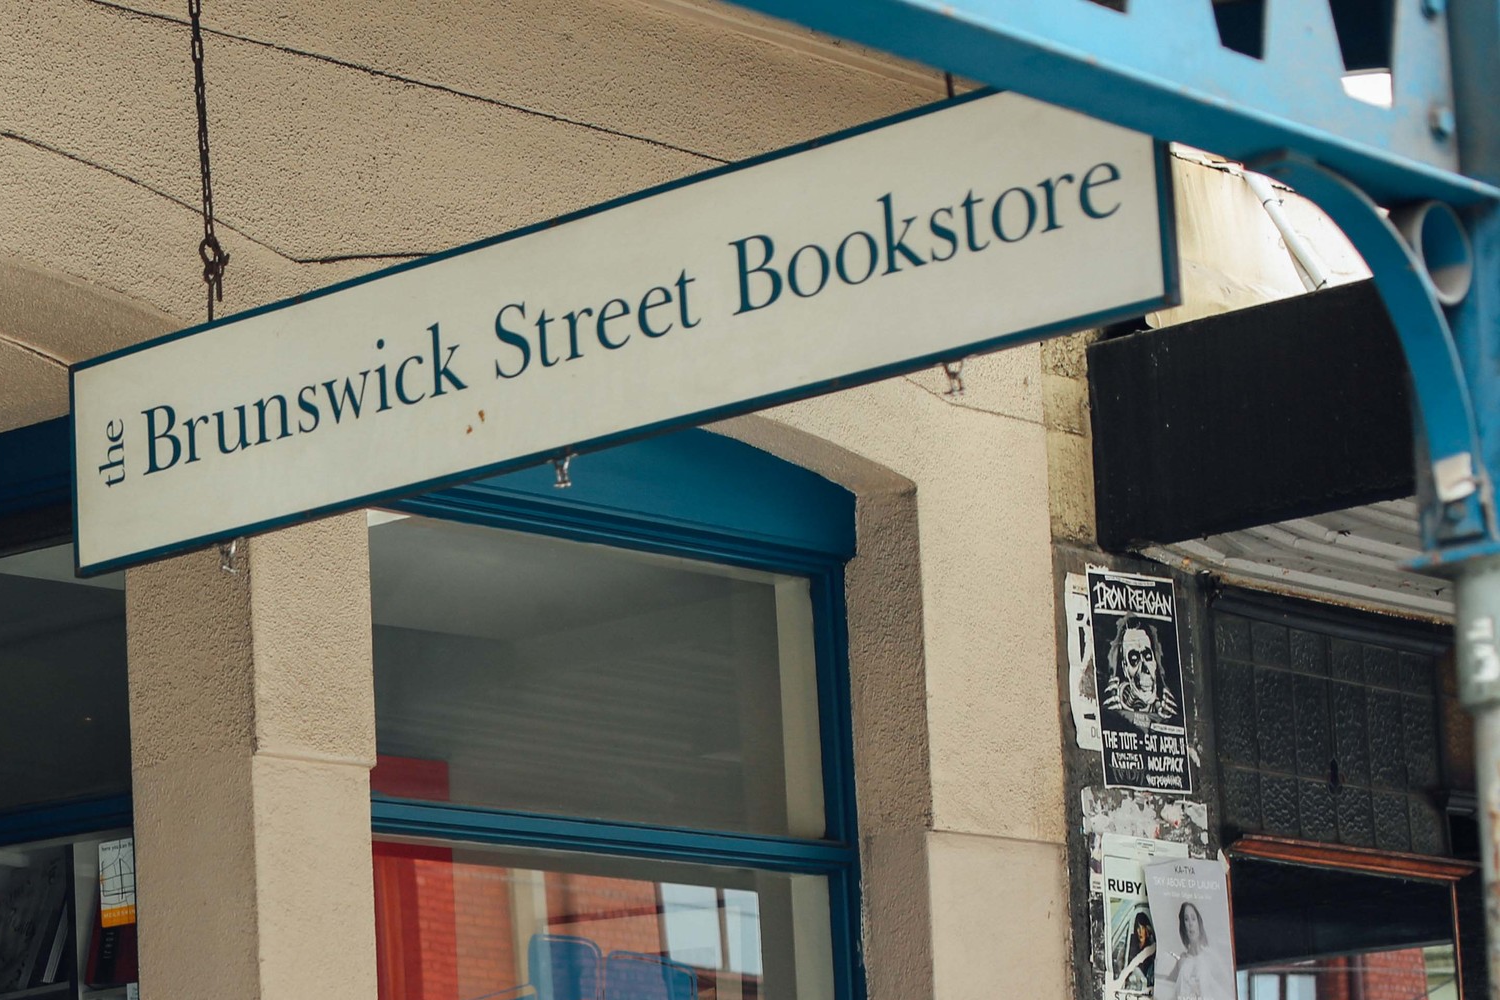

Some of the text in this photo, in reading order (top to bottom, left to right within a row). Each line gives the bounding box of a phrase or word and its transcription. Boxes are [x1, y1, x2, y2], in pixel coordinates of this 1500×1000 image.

[98, 160, 1123, 489] the Brunswick Street Bookstore
[1093, 581, 1126, 610] IRON
[1126, 585, 1173, 615] REAGAN
[1103, 730, 1118, 749] THE
[1119, 732, 1138, 750] TOTE
[1144, 734, 1158, 752] SAT
[1160, 736, 1179, 755] APRIL
[1147, 756, 1184, 773] WOLFPACK
[1174, 864, 1196, 875] KA-TYA
[1108, 878, 1142, 896] RUBY
